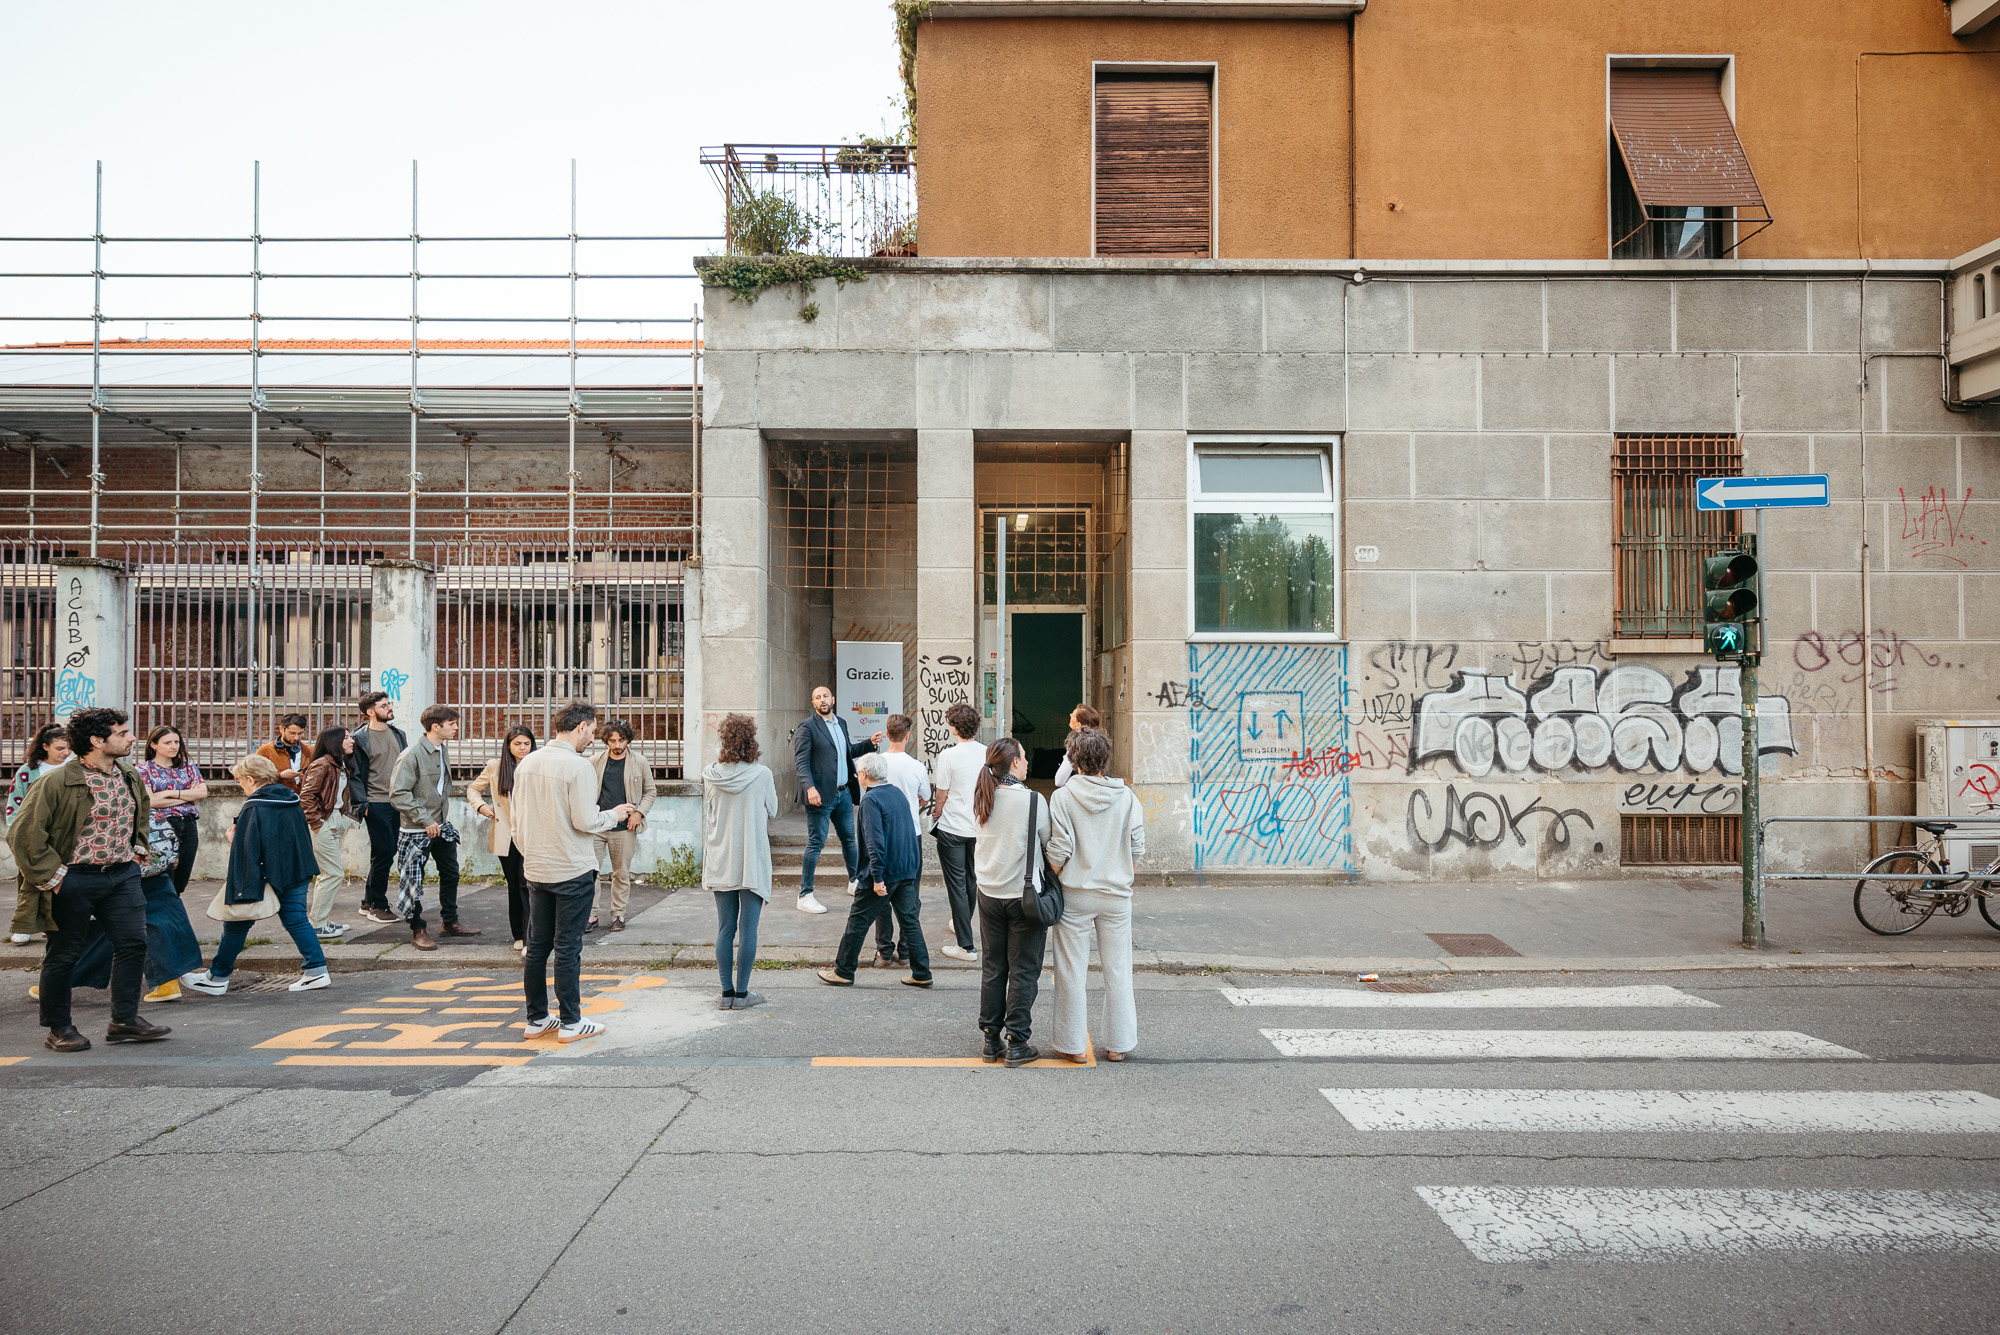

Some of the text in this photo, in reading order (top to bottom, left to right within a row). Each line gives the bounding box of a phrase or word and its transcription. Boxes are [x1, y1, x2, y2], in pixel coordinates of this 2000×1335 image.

[1358, 547, 1375, 561] 20
[67, 577, 83, 644] ACAB
[846, 667, 894, 680] Grazie.
[928, 687, 969, 705] SCUSA
[923, 727, 950, 742] SOLO
